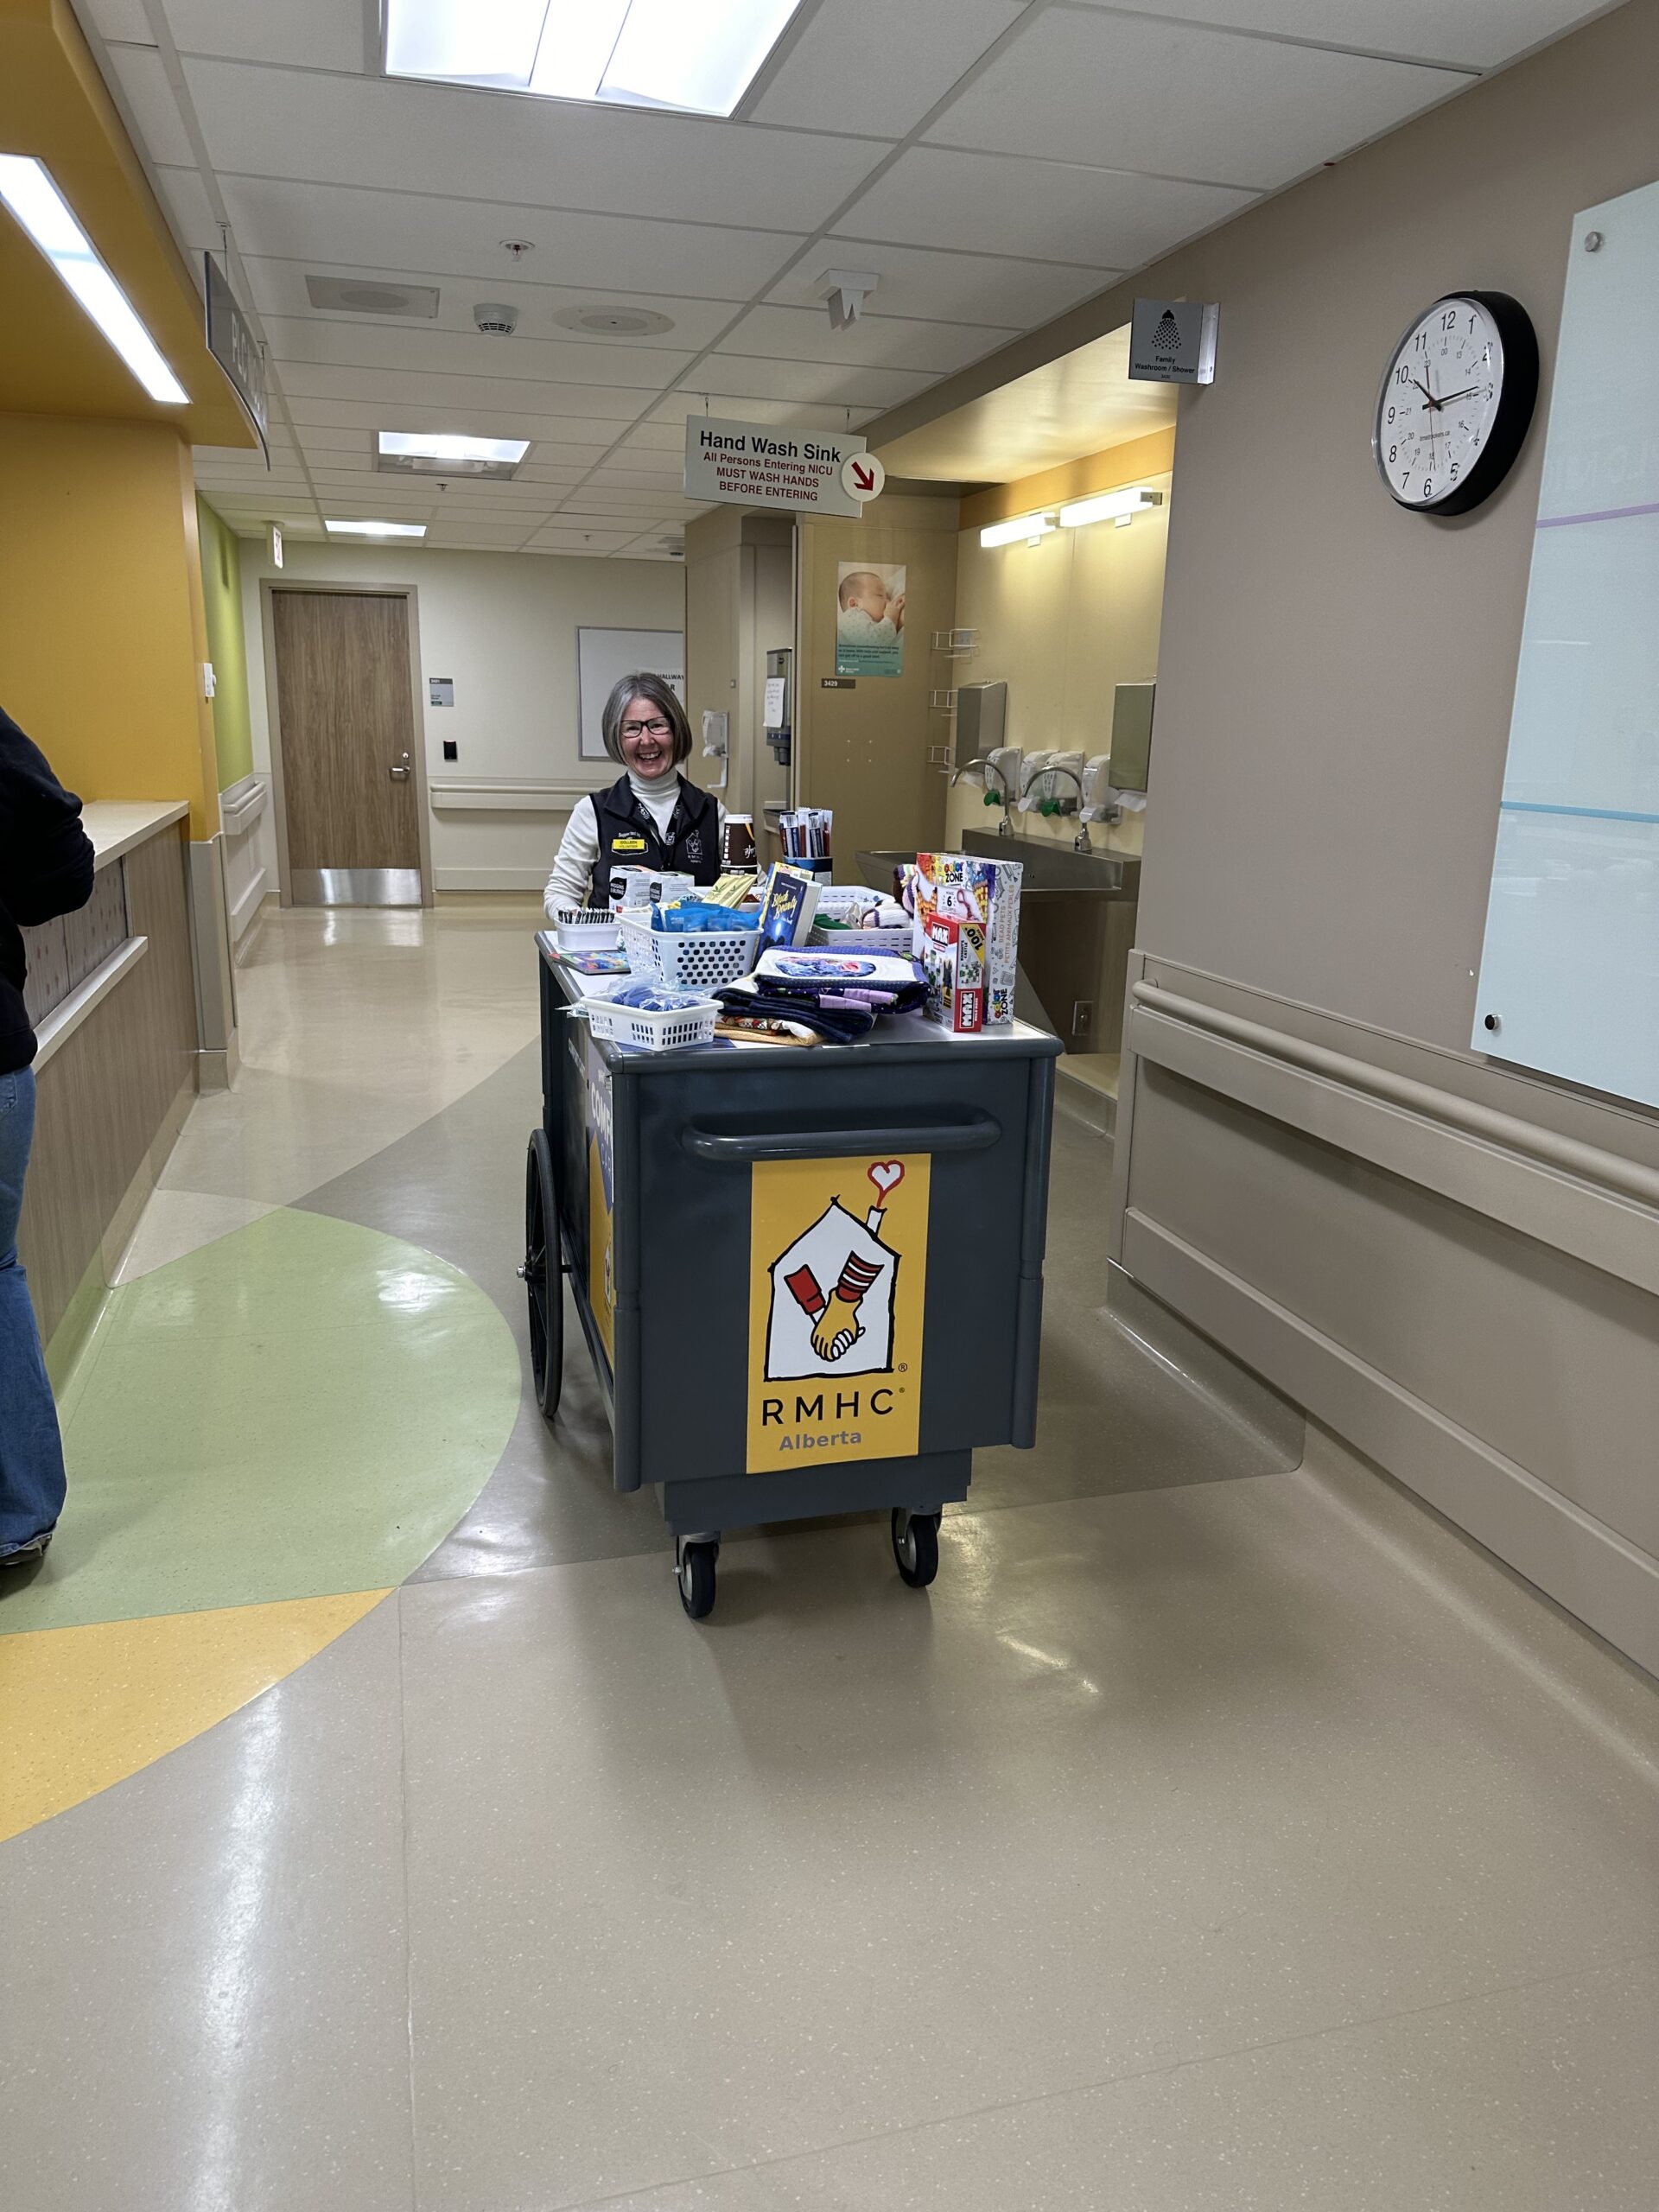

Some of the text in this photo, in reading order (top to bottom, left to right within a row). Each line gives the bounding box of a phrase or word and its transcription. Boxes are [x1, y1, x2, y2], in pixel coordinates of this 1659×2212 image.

[1441, 311, 1456, 331] 12
[1469, 315, 1477, 334] 1
[1415, 332, 1427, 352] 11
[1135, 363, 1167, 372] Washroom
[1172, 365, 1195, 374] Shower
[1155, 355, 1176, 365] Family
[1395, 365, 1409, 385] 10
[1388, 406, 1395, 424] 9
[700, 430, 842, 463] Hand Wash Sink
[1389, 445, 1397, 463] 8
[703, 451, 833, 476] All Persons Entering NICU
[1450, 463, 1459, 481] 5
[716, 467, 819, 487] MUST WASH HANDS
[1402, 472, 1410, 490] 7
[719, 481, 818, 501] BEFORE ENTERING
[1423, 478, 1433, 498] 6
[945, 873, 963, 883] ZONE
[947, 895, 952, 907] 6
[931, 925, 949, 944] MAX
[962, 993, 973, 1027] MAX
[761, 1389, 893, 1427] RMHC
[779, 1431, 862, 1452] Alberta
